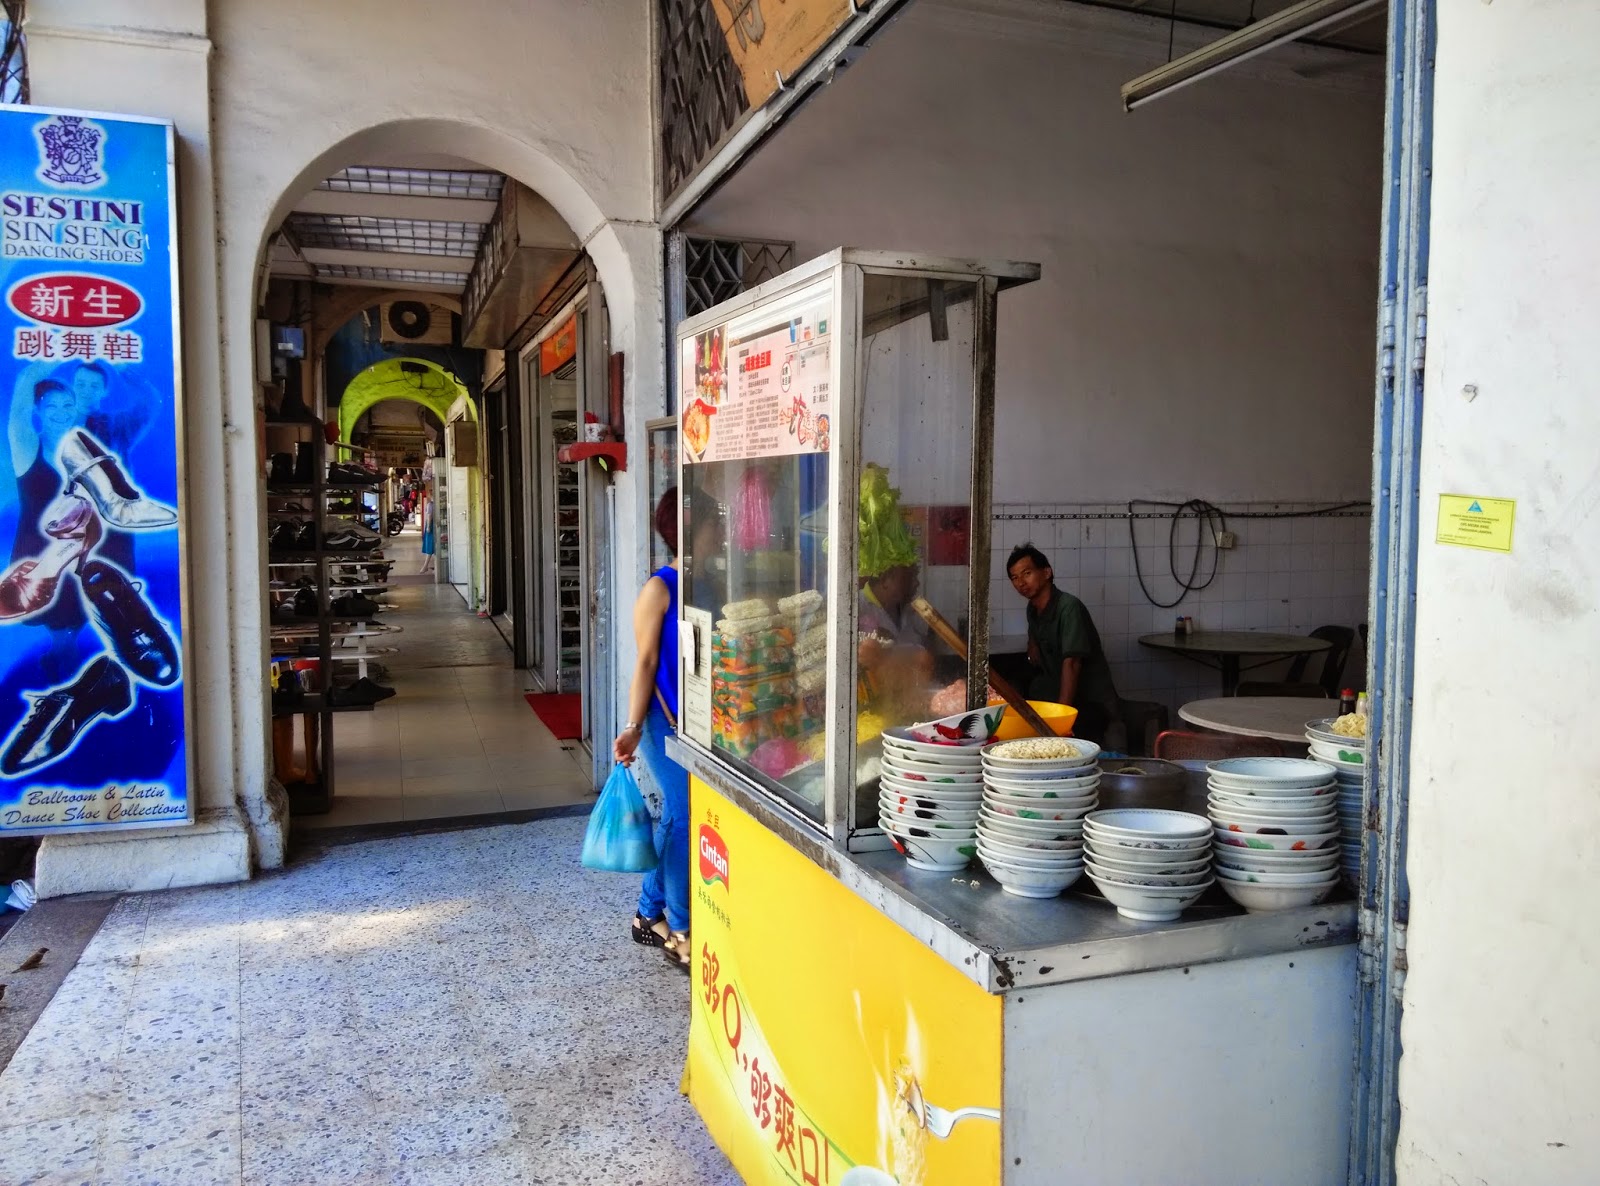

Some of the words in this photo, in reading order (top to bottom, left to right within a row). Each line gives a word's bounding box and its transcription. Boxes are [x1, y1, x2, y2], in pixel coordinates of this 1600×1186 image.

[3, 194, 142, 225] SESTINI
[6, 221, 55, 243] SIN
[66, 225, 144, 250] SENG
[4, 244, 84, 260] DANCING
[90, 246, 143, 263] SHOES
[30, 283, 125, 319] 新生
[18, 330, 139, 360] 跳舞鞋
[28, 791, 97, 806] Ballroom
[104, 786, 116, 800] &
[121, 785, 165, 800] Latin
[4, 811, 55, 825] Dance
[61, 805, 100, 822] Shoe
[107, 803, 186, 821] Collections
[700, 835, 728, 877] Cintan
